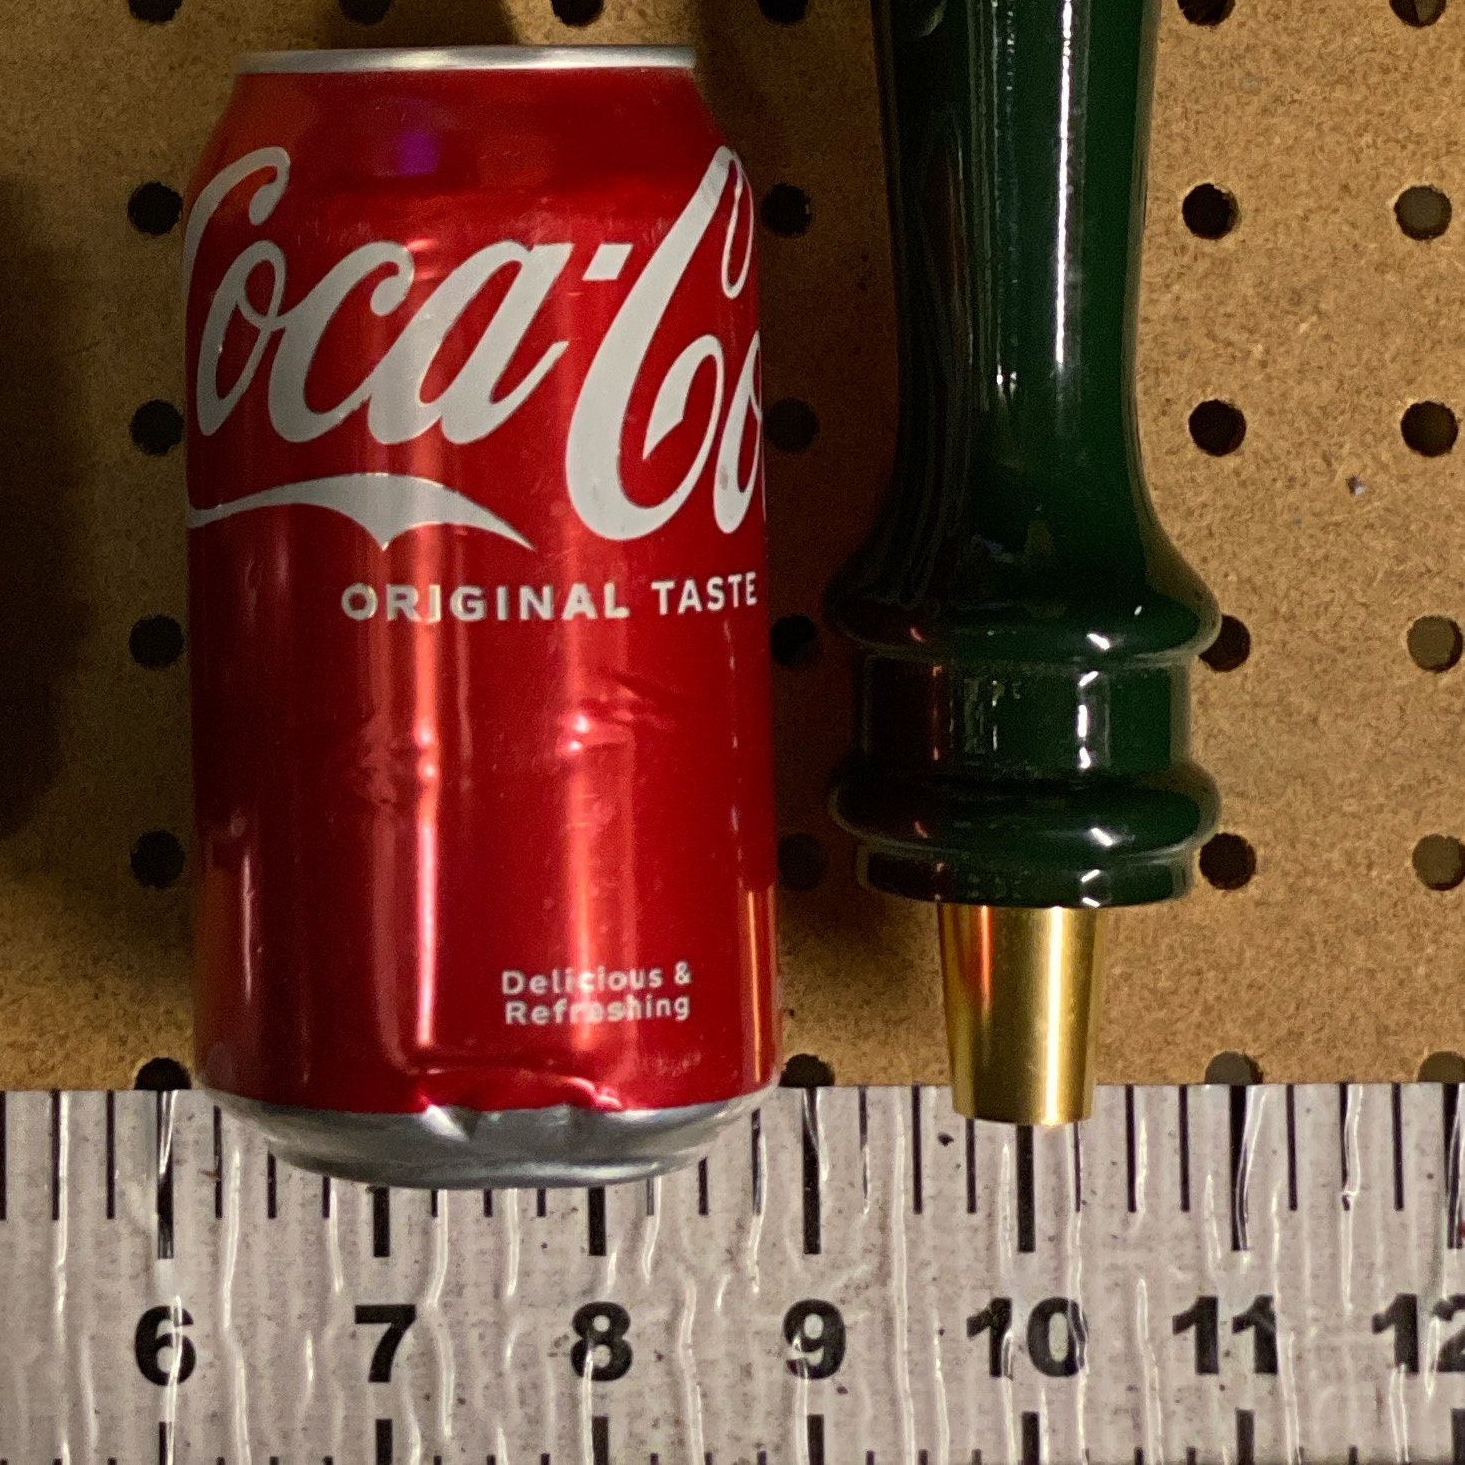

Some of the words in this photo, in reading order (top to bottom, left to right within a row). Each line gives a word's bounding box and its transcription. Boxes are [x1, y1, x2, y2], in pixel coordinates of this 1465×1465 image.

[340, 582, 631, 625] ORIGINAL
[650, 570, 759, 616] TASTE
[501, 966, 663, 995] Delicious
[674, 960, 693, 986] &
[505, 994, 690, 1025] Refreshing
[134, 1304, 197, 1386] 6
[354, 1304, 417, 1383] 7
[570, 1302, 632, 1382] 8
[782, 1298, 847, 1380] 9
[966, 1296, 1088, 1378] 10
[1172, 1295, 1280, 1376] 11
